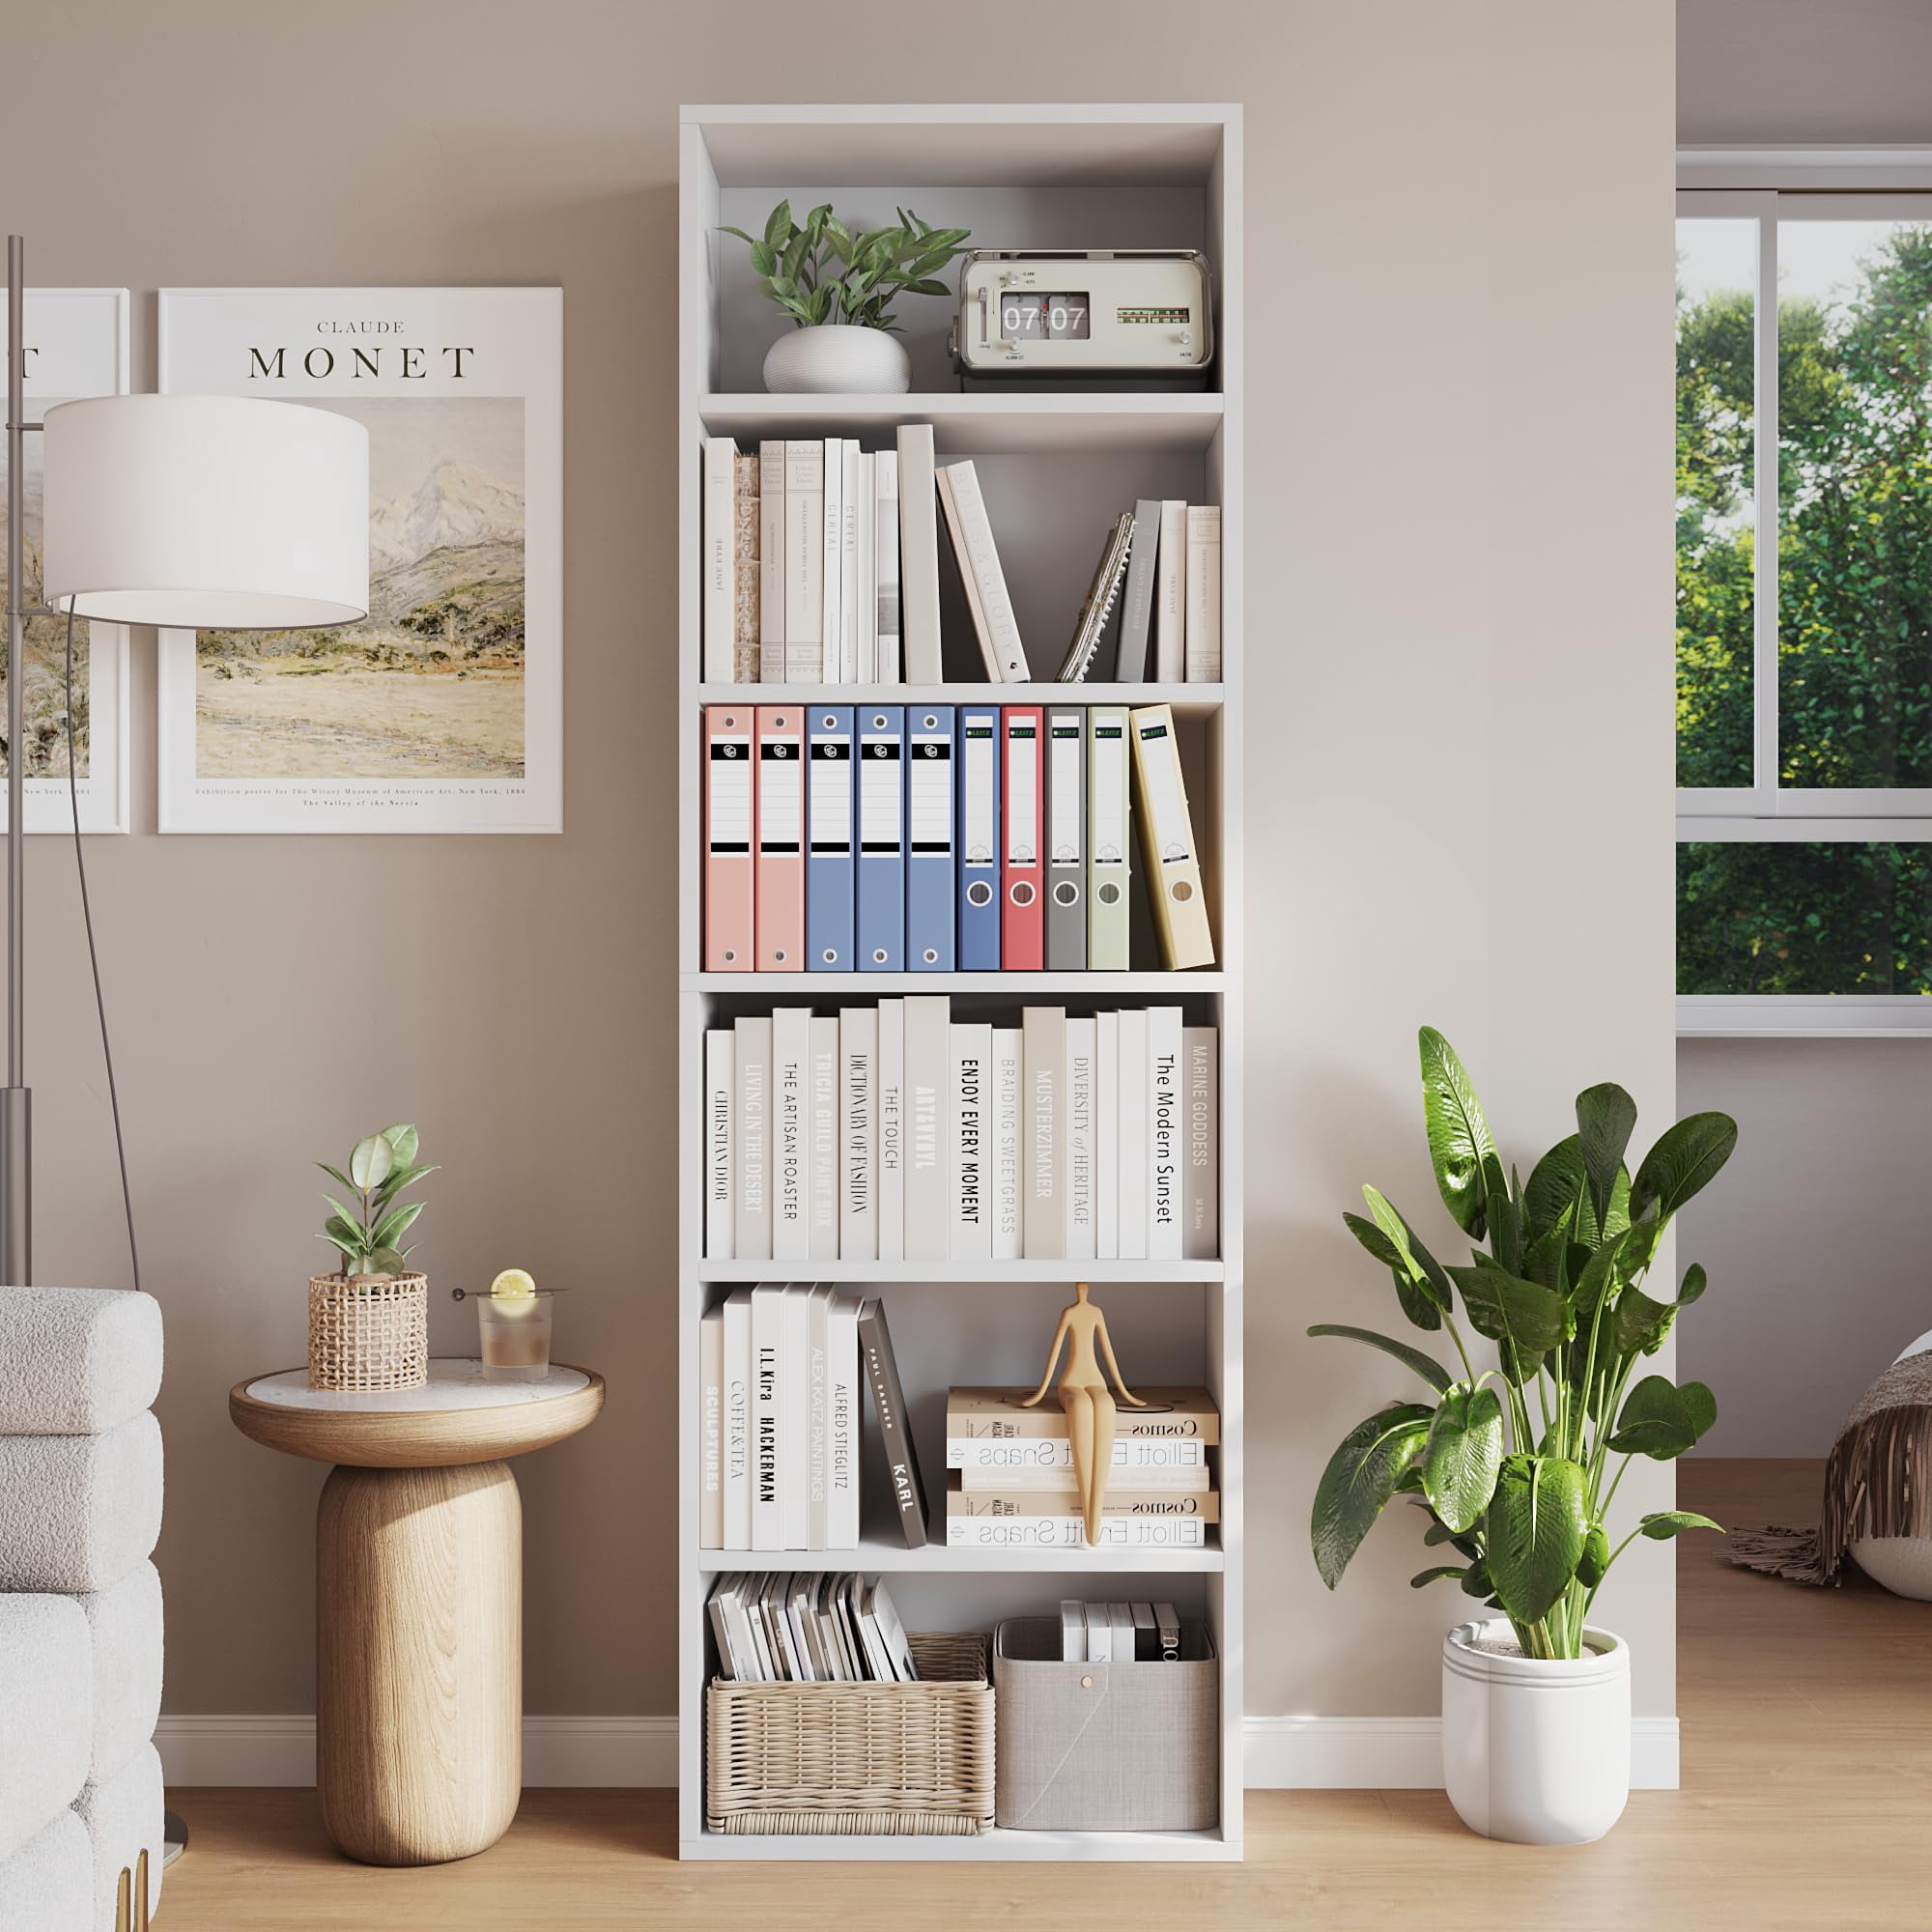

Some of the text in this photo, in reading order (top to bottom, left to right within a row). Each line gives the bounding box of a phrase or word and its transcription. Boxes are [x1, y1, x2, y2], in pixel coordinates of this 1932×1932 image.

[248, 347, 474, 379] MONET
[317, 322, 405, 333] CLAUDE
[1004, 307, 1085, 330] 07 07
[827, 504, 837, 552] CEREAL
[845, 505, 857, 552] CEREAL
[815, 1051, 833, 1101] TRICIA
[886, 1087, 898, 1169] THE TOUCH
[1192, 1045, 1208, 1167] MARINE GODDESS
[715, 1091, 728, 1201] CHRISTIAN DIOR
[745, 1064, 761, 1213] LIVING IN THE DESERT
[783, 1063, 798, 1220] THE ARTISAN ROASTER
[815, 1109, 833, 1151] GUILD
[850, 1055, 867, 1213] DICTIONARY OF FASHION
[961, 1060, 980, 1224] ENJOY EVERY MOMENT
[1001, 1059, 1016, 1234] BRAIDING SWEETGRASS
[1036, 1070, 1053, 1198] MUSTERZIMMER
[1073, 1058, 1089, 1225] DIVERSITY of HERITAGE
[1156, 1054, 1175, 1224] The Modern Sunset
[868, 1348, 881, 1377] PAUL
[706, 1385, 719, 1492] SCULPTURES
[731, 1380, 746, 1479] COFFE&TEA
[759, 1417, 775, 1502] HACKERMAN
[811, 1348, 824, 1502] ALEX KATZ PAINTINGS
[835, 1383, 848, 1489] ALFRED STIEGLITZ
[893, 1463, 914, 1513] KARL
